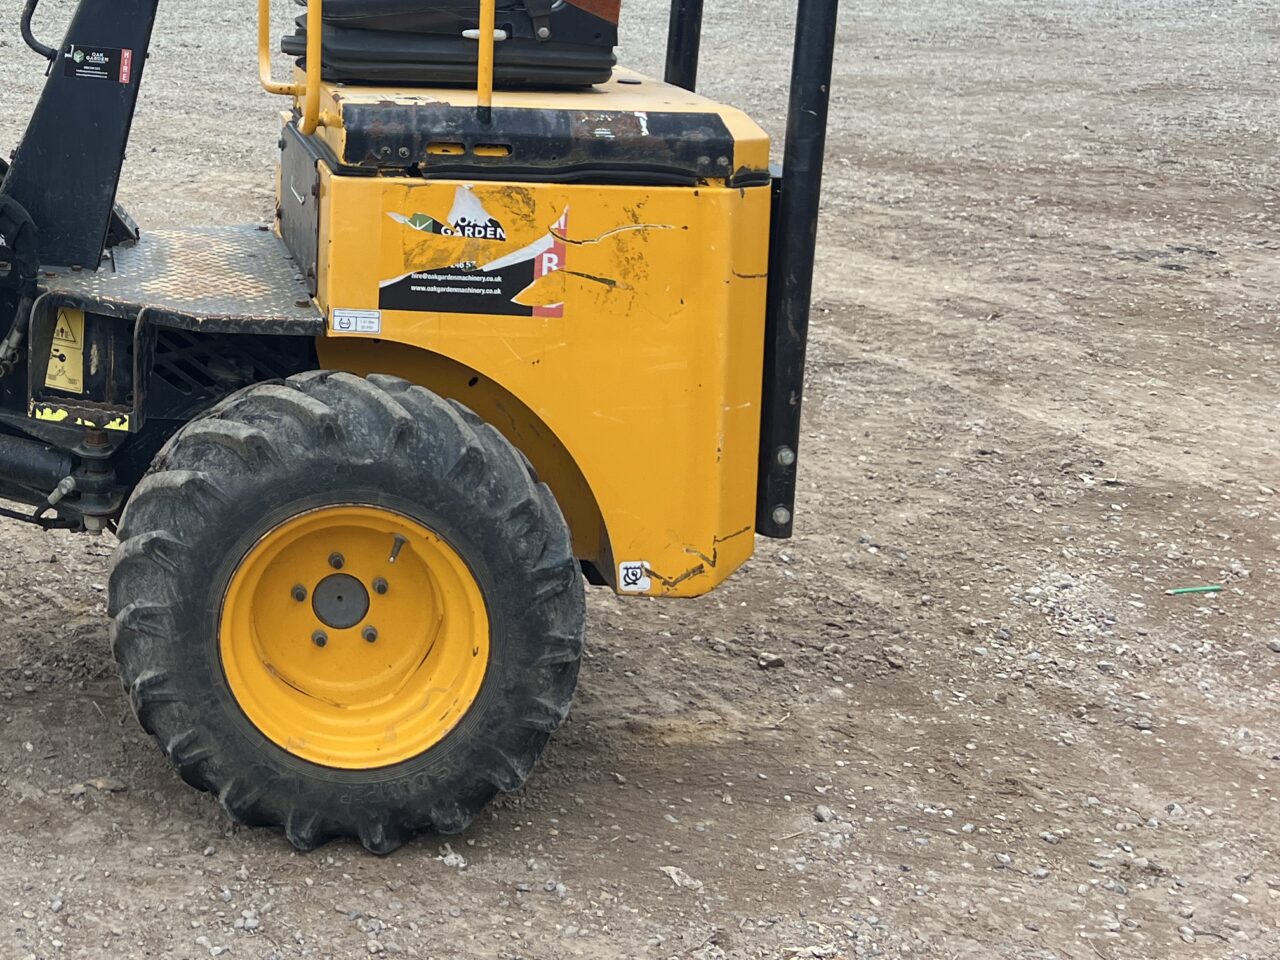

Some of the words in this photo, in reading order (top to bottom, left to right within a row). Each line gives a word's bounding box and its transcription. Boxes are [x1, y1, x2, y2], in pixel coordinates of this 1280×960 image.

[122, 51, 130, 80] HIRE
[440, 226, 506, 239] GARDEN
[410, 285, 502, 295] www.oakgardenmachinery.co.uk
